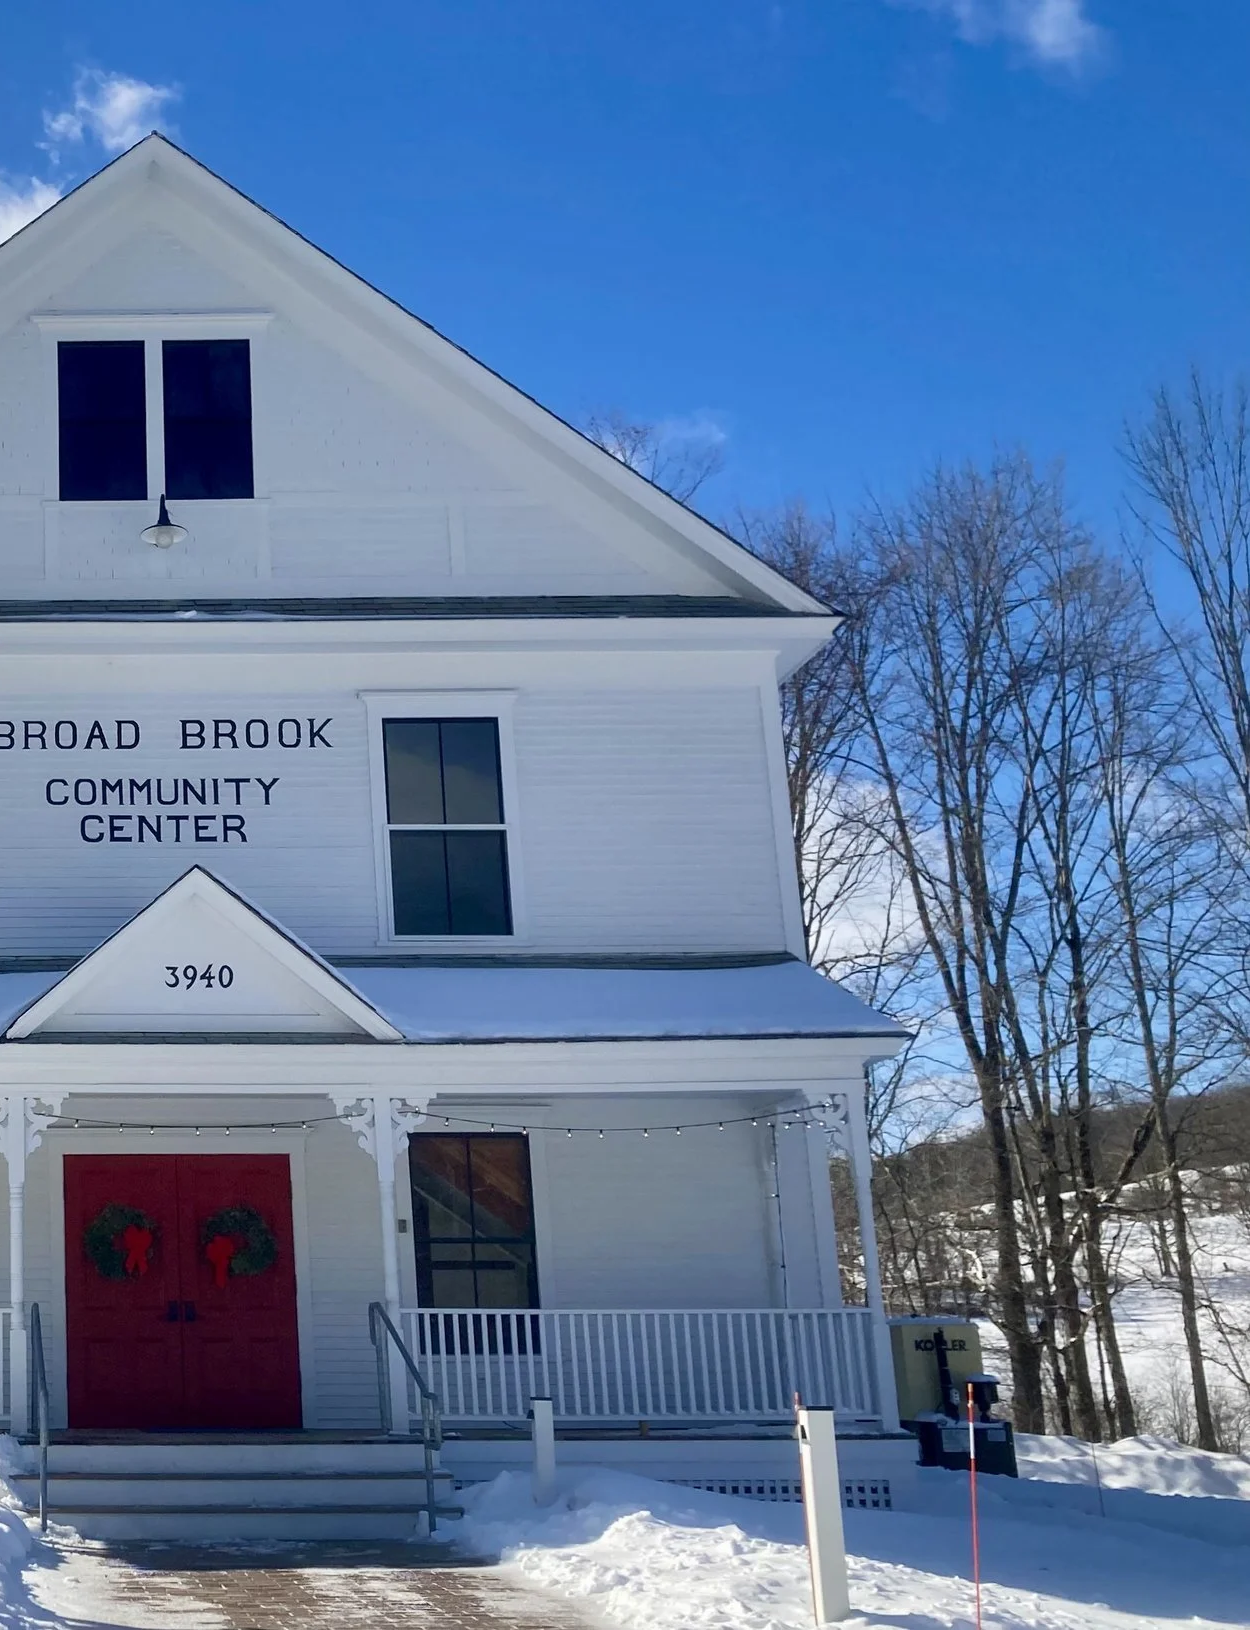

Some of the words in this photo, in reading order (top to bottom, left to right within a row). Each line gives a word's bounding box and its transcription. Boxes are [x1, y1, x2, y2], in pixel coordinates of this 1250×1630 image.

[179, 718, 334, 749] BROOK
[46, 778, 280, 805] COMMUNITY
[81, 815, 248, 843] CENTER
[165, 963, 233, 990] 3940
